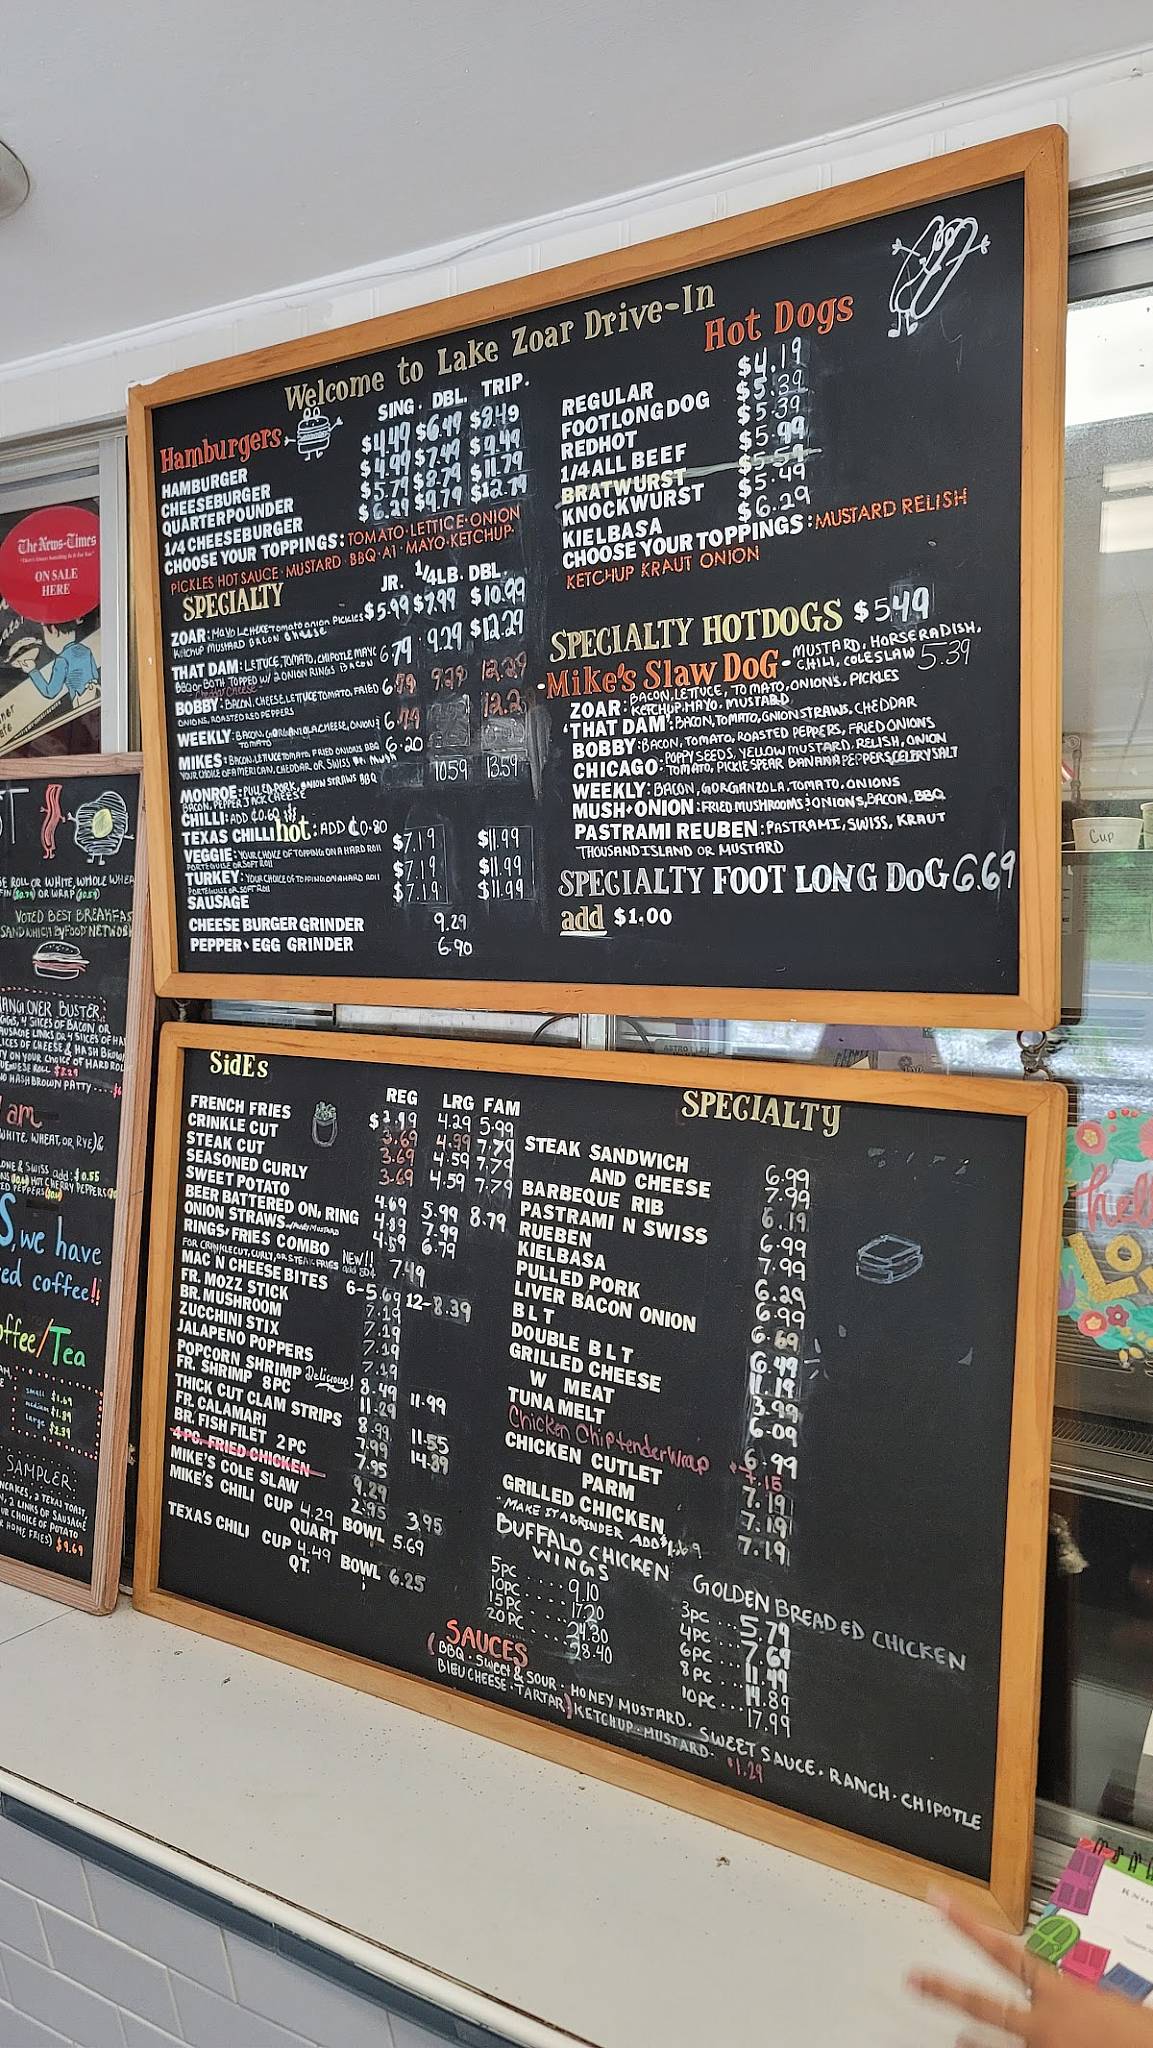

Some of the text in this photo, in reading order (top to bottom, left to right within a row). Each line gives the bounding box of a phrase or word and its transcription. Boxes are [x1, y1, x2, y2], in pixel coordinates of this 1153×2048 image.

[705, 295, 854, 352] Hot Dogs
[285, 284, 716, 411] Welcome to Lake Zoar Drive-In
[562, 337, 802, 416] REGULAR $4.19
[360, 422, 409, 454] $4.49
[561, 395, 801, 460] REDHOT $5.39
[160, 427, 284, 473] Hamburgers
[360, 447, 410, 478] $4.99
[632, 444, 687, 472] BEEF
[161, 468, 248, 499] HAMBURGER
[161, 483, 271, 518] CHEESEBURGER
[360, 467, 409, 501] $5.79
[561, 469, 687, 505] BRATWURST
[562, 465, 805, 526] KNOCKWURST $5.49
[162, 498, 294, 537] QUARTERPOUNDER
[562, 488, 967, 570] CHOOSE YOUR MUSTARD RELISH
[562, 518, 662, 548] KIELBASA
[17, 534, 97, 553] The News-Times
[35, 567, 78, 582] ON SALE
[164, 557, 219, 576] CHOOSE
[222, 549, 257, 570] YOUR
[566, 545, 759, 589] KETCHUP KRAUT ONION
[42, 582, 70, 597] HERE
[183, 582, 284, 622] SPECIALTY
[364, 577, 526, 622] $5.99 $10.99
[549, 599, 843, 662] SPECIALTY HOTDOGS
[172, 649, 352, 679] THAT DAM: CHIPOTLE
[546, 621, 982, 699] Mike's Slaw HORSERADISH,
[849, 669, 899, 685] PICKLES
[854, 696, 917, 714] CHEDDAR
[178, 729, 234, 747] WEEKLY:
[737, 724, 845, 743] ROASTED PEPPERS,
[574, 759, 663, 779] CHICAGO:
[573, 777, 900, 799] WEEKLY: ONIONS
[182, 829, 228, 846] TEXAS
[478, 828, 519, 849] $11.99
[574, 812, 946, 840] PASTRAMI KRAUT
[1089, 828, 1114, 844] Cup
[718, 841, 784, 855] MUSTARD
[558, 866, 704, 897] SPECIALTY
[712, 865, 786, 894] FOOT
[795, 862, 878, 893] LONG
[951, 849, 1016, 892] 6.69
[15, 908, 72, 924] VOTED BEST
[188, 896, 249, 910] SAUSAGE
[561, 904, 604, 931] add
[189, 917, 364, 932] CHEESE BURGER GRINDER
[252, 937, 472, 957] EGG GRINDER 6.90
[58, 1003, 99, 1019] BUSTER
[66, 1017, 96, 1033] BACON
[190, 1095, 471, 1132] FRENCH FRIES 4.29
[387, 1088, 520, 1117] REG LRG FAM
[681, 1090, 842, 1137] SPECIALTY
[188, 1113, 279, 1137] CRINKLE CUT
[186, 1150, 308, 1179] SEASONED CURLY
[525, 1136, 809, 1189] STEAK SANDWICH 6.99
[186, 1167, 290, 1196] SWEET POTATO
[522, 1180, 664, 1215] BARBEQUE RIB
[635, 1172, 711, 1198] CHEESE
[185, 1185, 458, 1224] BEER BATTERED 5.99
[20, 1216, 102, 1265] we have
[276, 1234, 455, 1259] COMBO 6.79
[521, 1201, 806, 1258] PASTRAMI SWISS 6.99
[518, 1241, 606, 1270] KIELBASA
[516, 1262, 641, 1298] PULLED PORK
[514, 1281, 696, 1332] LIVER BACON ONION
[177, 1319, 313, 1361] JALAPENO POPPERS
[178, 1340, 302, 1379] POPCORN SHRIMP
[509, 1342, 661, 1393] GRILLED CHEESE
[25, 1386, 45, 1397] small
[247, 1391, 342, 1426] CLAM STRIPS
[508, 1386, 605, 1425] TUNA MELT
[198, 1396, 266, 1426] CALAMARI
[198, 1413, 267, 1443] FISH FILET
[170, 1445, 299, 1493] MIKE'S COLE SLAW
[505, 1432, 662, 1486] CHICKEN CUTLET
[50, 1522, 78, 1538] POTATO
[168, 1502, 249, 1537] TEXAS CHILI
[264, 1494, 424, 1556] CUP BOWL 5.69
[496, 1512, 670, 1582] BUFFALO CHICKEN
[532, 1546, 609, 1582] WINGS
[693, 1574, 967, 1672] GOLDEN BREADED CHICKEN
[446, 1619, 791, 1738] SAUCES 17.99
[526, 1669, 982, 1832] SOUR HONEY SWEET CHIPOTLE
